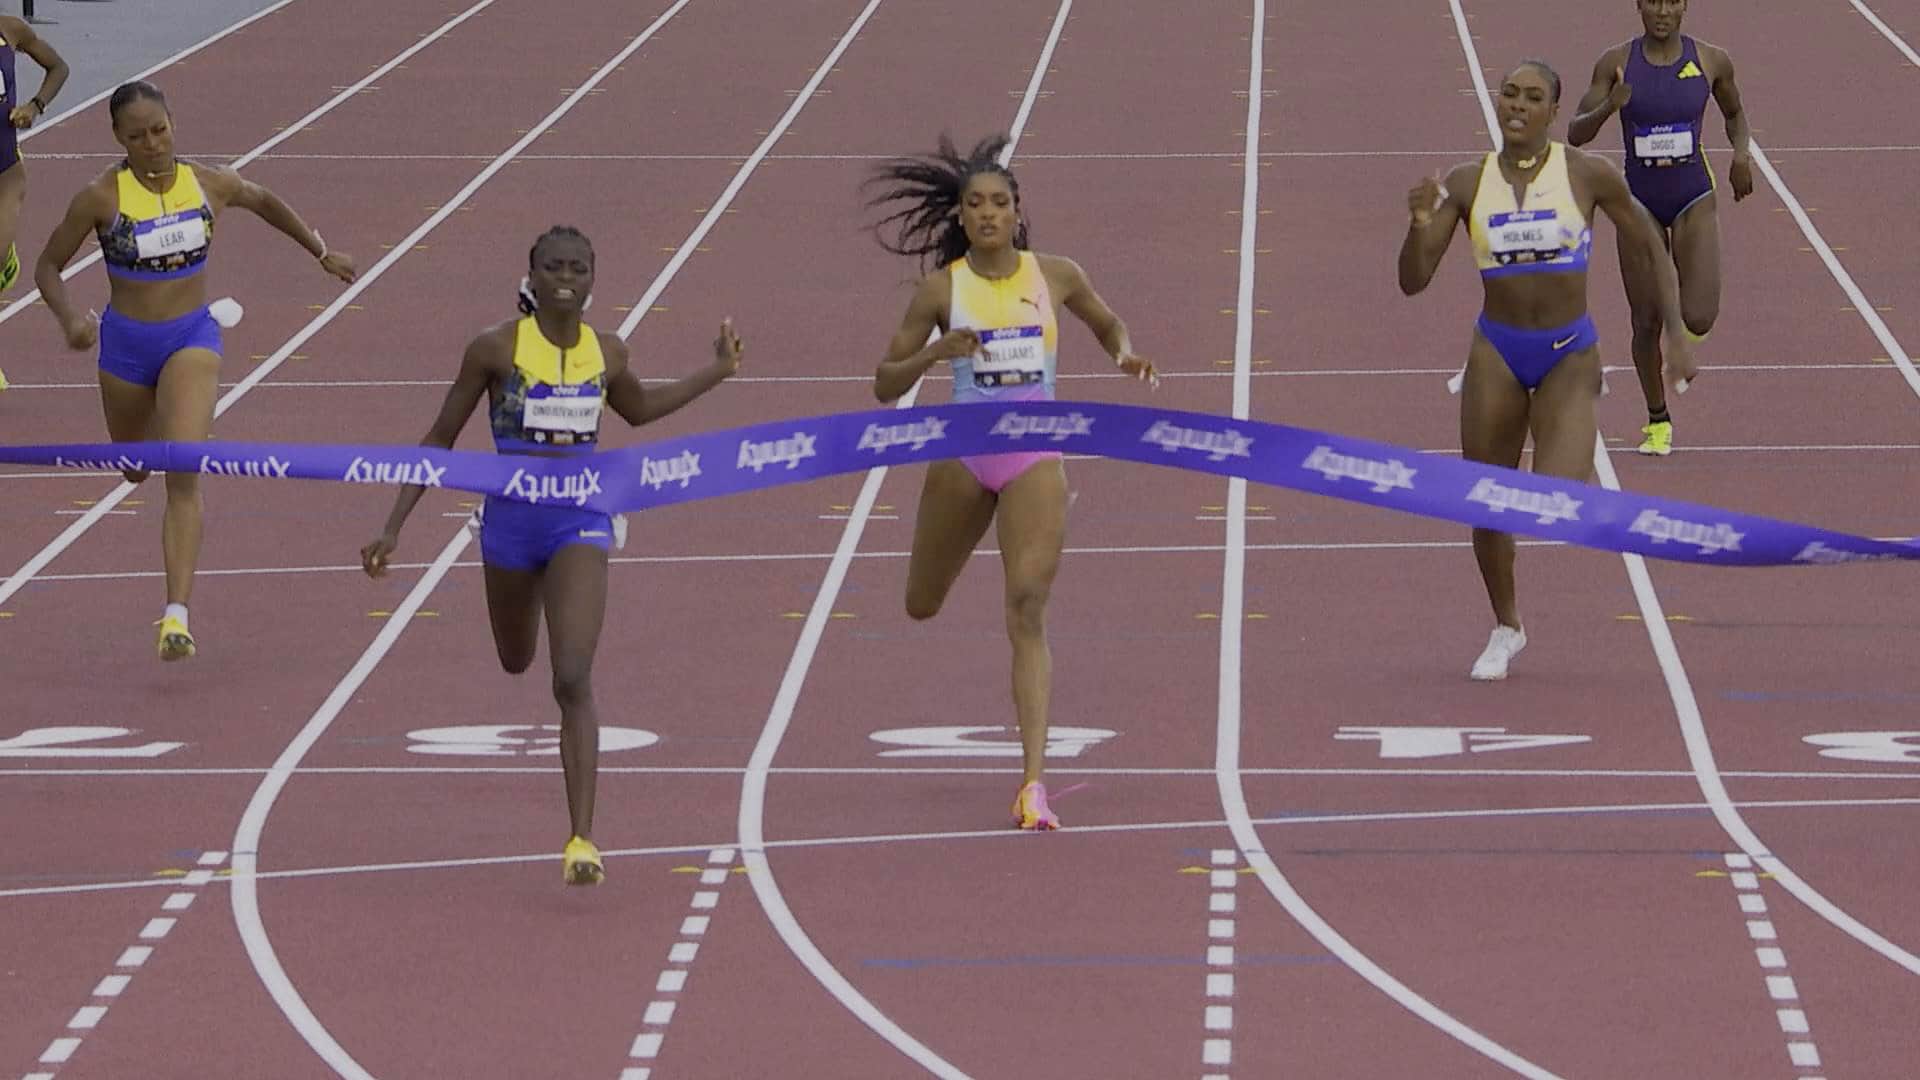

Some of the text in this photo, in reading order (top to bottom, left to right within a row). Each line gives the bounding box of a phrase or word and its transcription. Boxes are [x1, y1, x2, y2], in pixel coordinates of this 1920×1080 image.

[1651, 139, 1675, 151] DIGGS
[160, 231, 185, 248] LEAR
[1503, 229, 1544, 243] HOLMES
[737, 431, 817, 473] xfinity
[640, 450, 703, 490] xfinity
[503, 466, 603, 506] xfinity
[406, 725, 660, 756] 6
[869, 726, 1118, 757] 5
[1334, 726, 1593, 758] 4
